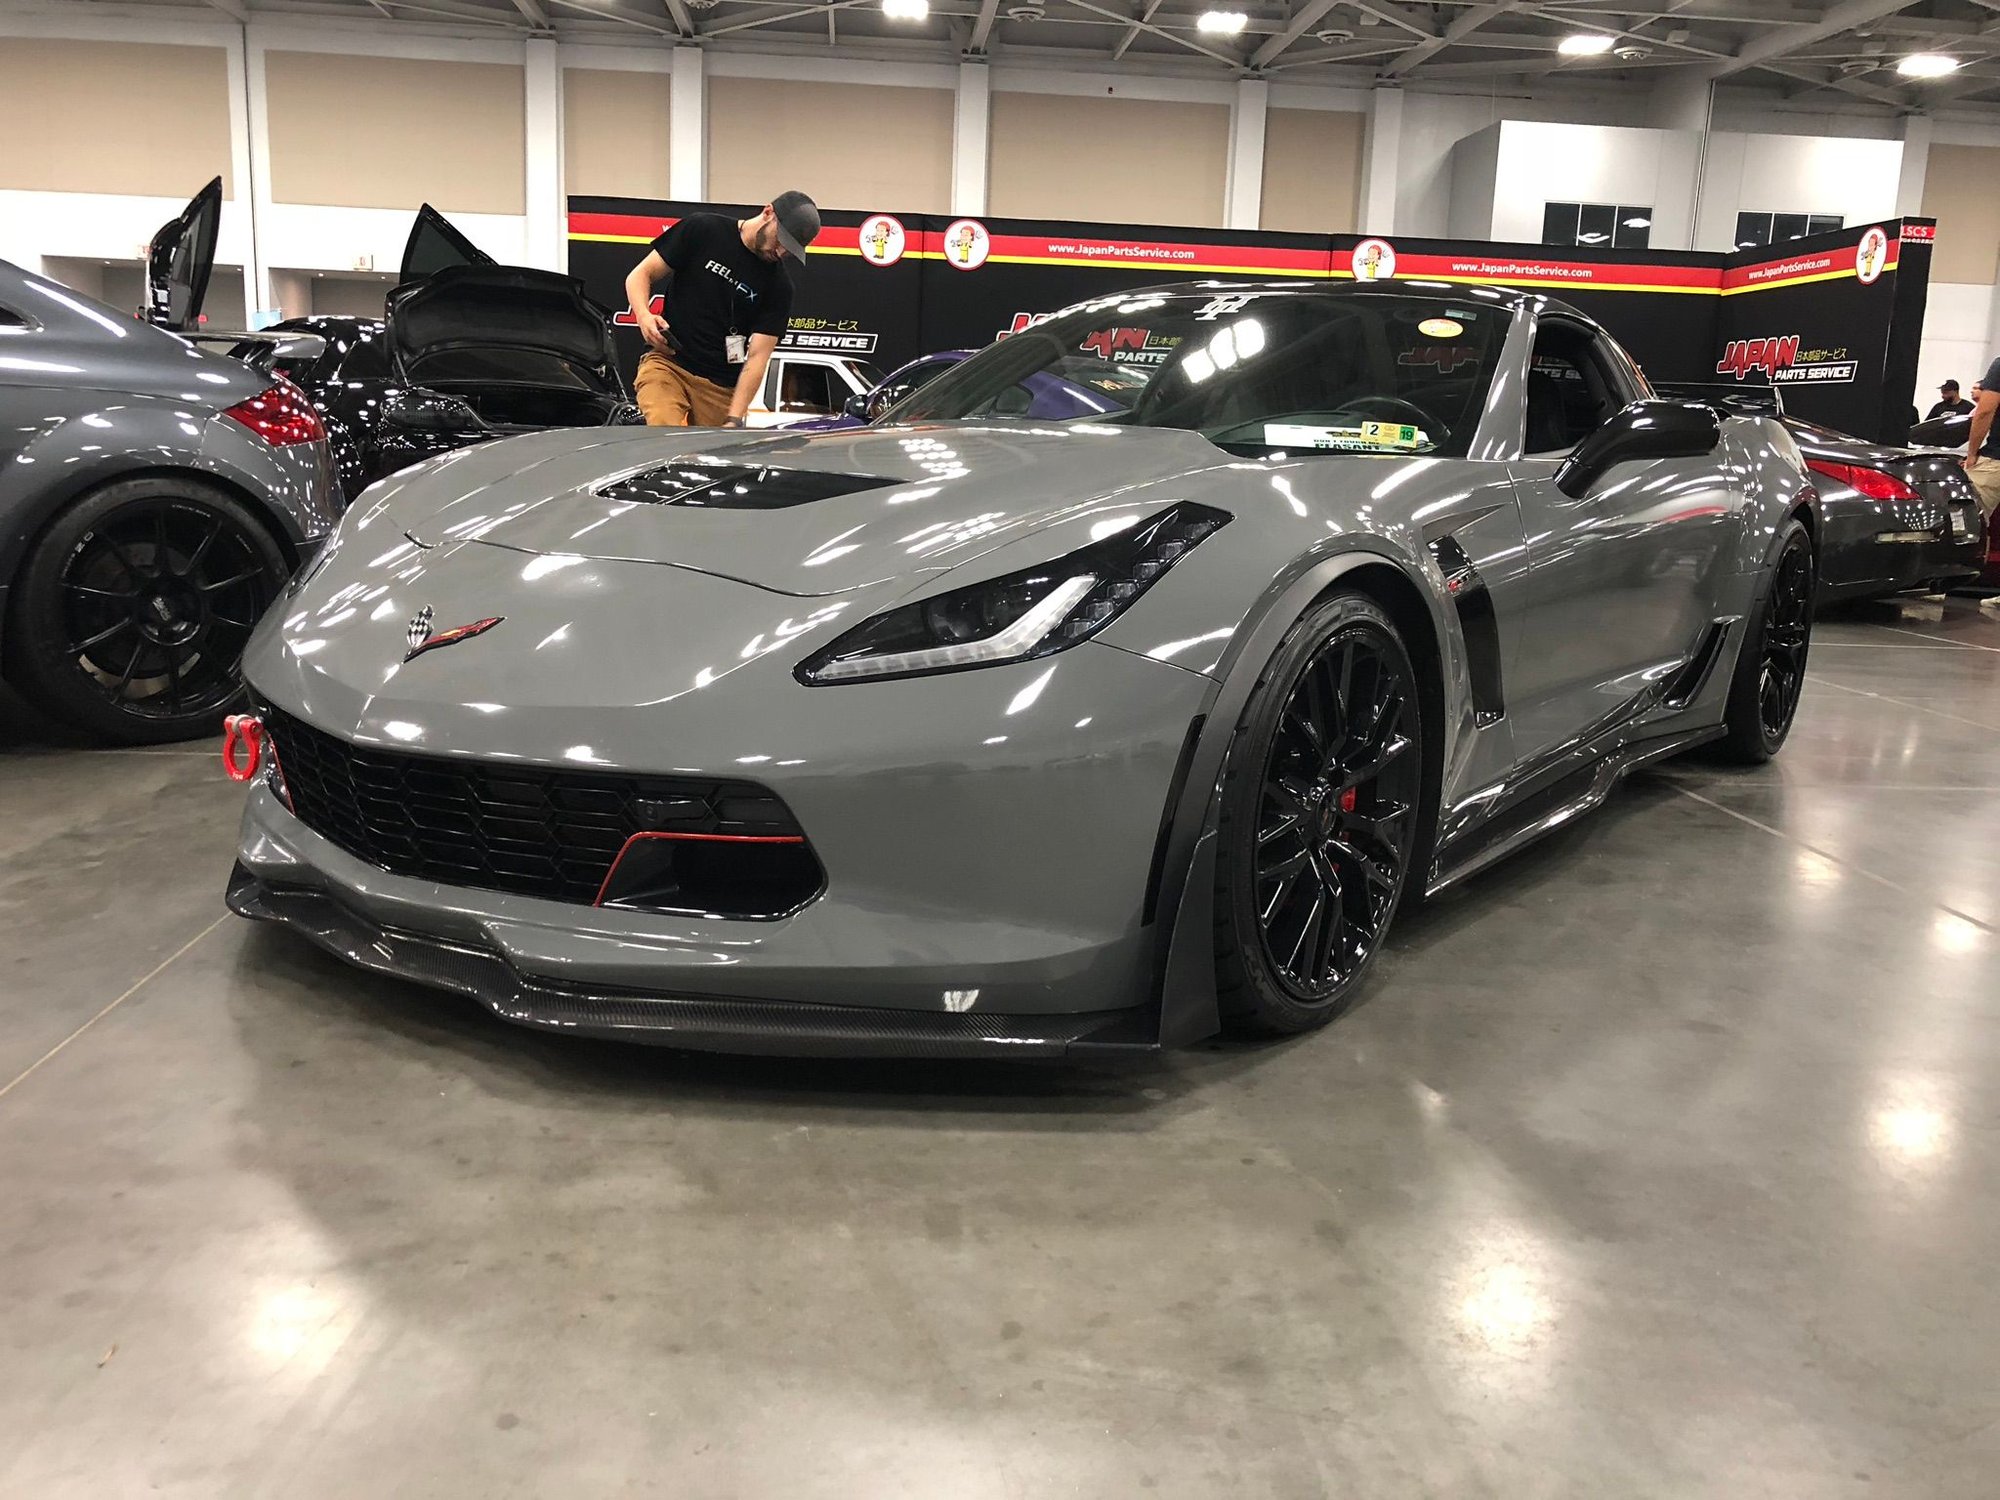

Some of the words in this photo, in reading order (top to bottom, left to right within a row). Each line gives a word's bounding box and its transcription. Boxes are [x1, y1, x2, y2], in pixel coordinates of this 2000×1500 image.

[1048, 244, 1195, 259] www.JapanPartsService.com
[704, 260, 733, 280] FEEL
[1452, 263, 1593, 278] www.JapanPartsService.com
[1748, 258, 1831, 280] www.JapanPartsService.com
[796, 335, 869, 349] SERVICE
[1717, 335, 1800, 380] JAPAN
[1774, 368, 1806, 381] PARTS
[1806, 366, 1852, 379] SERVICE
[1369, 424, 1379, 436] 2
[1400, 430, 1414, 441] 19
